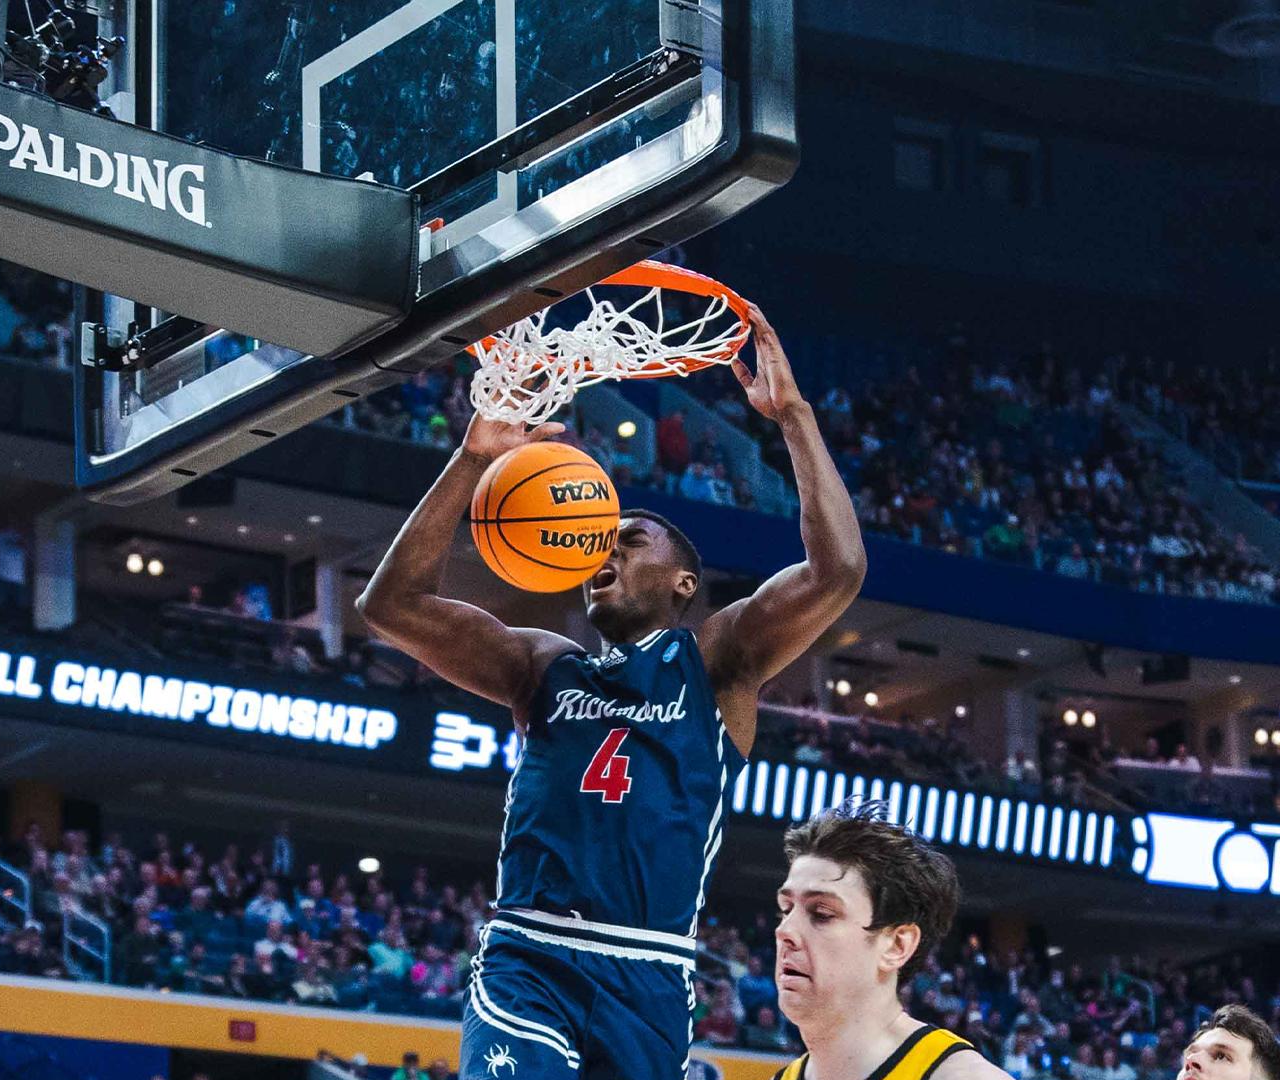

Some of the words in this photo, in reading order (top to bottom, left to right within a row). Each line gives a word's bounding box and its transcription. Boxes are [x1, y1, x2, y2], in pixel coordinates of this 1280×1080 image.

[549, 480, 611, 505] NCAA
[50, 661, 399, 750] CHAMPIONSHIP
[580, 727, 632, 803] 4
